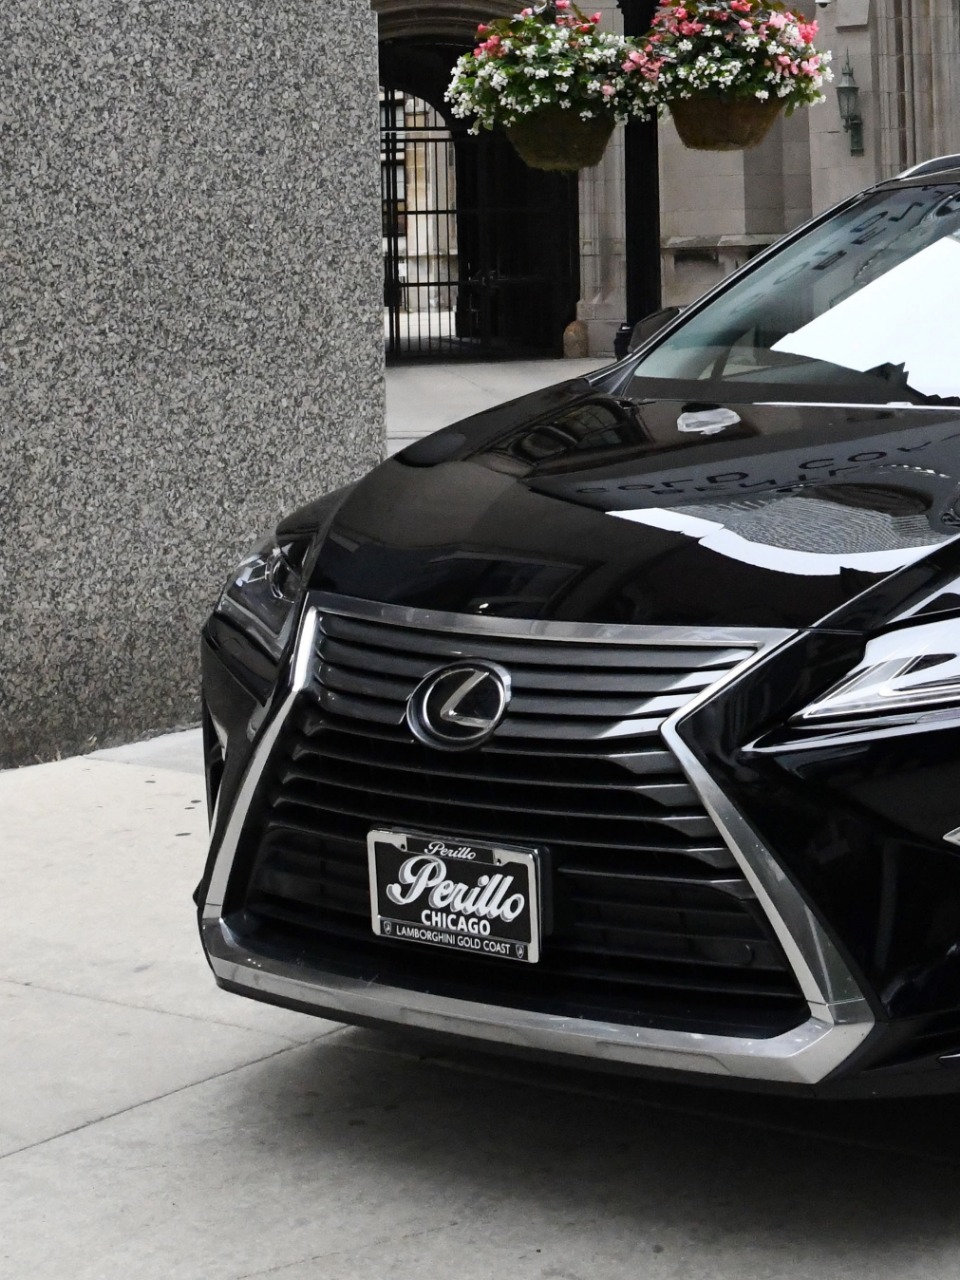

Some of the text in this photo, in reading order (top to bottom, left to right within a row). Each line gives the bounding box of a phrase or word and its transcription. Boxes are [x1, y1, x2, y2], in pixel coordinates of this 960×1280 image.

[424, 841, 477, 860] Perillo
[386, 855, 525, 922] Perillo
[421, 909, 491, 936] CHICAGO
[396, 924, 510, 955] LAMBORGHINI GOLD COAST
